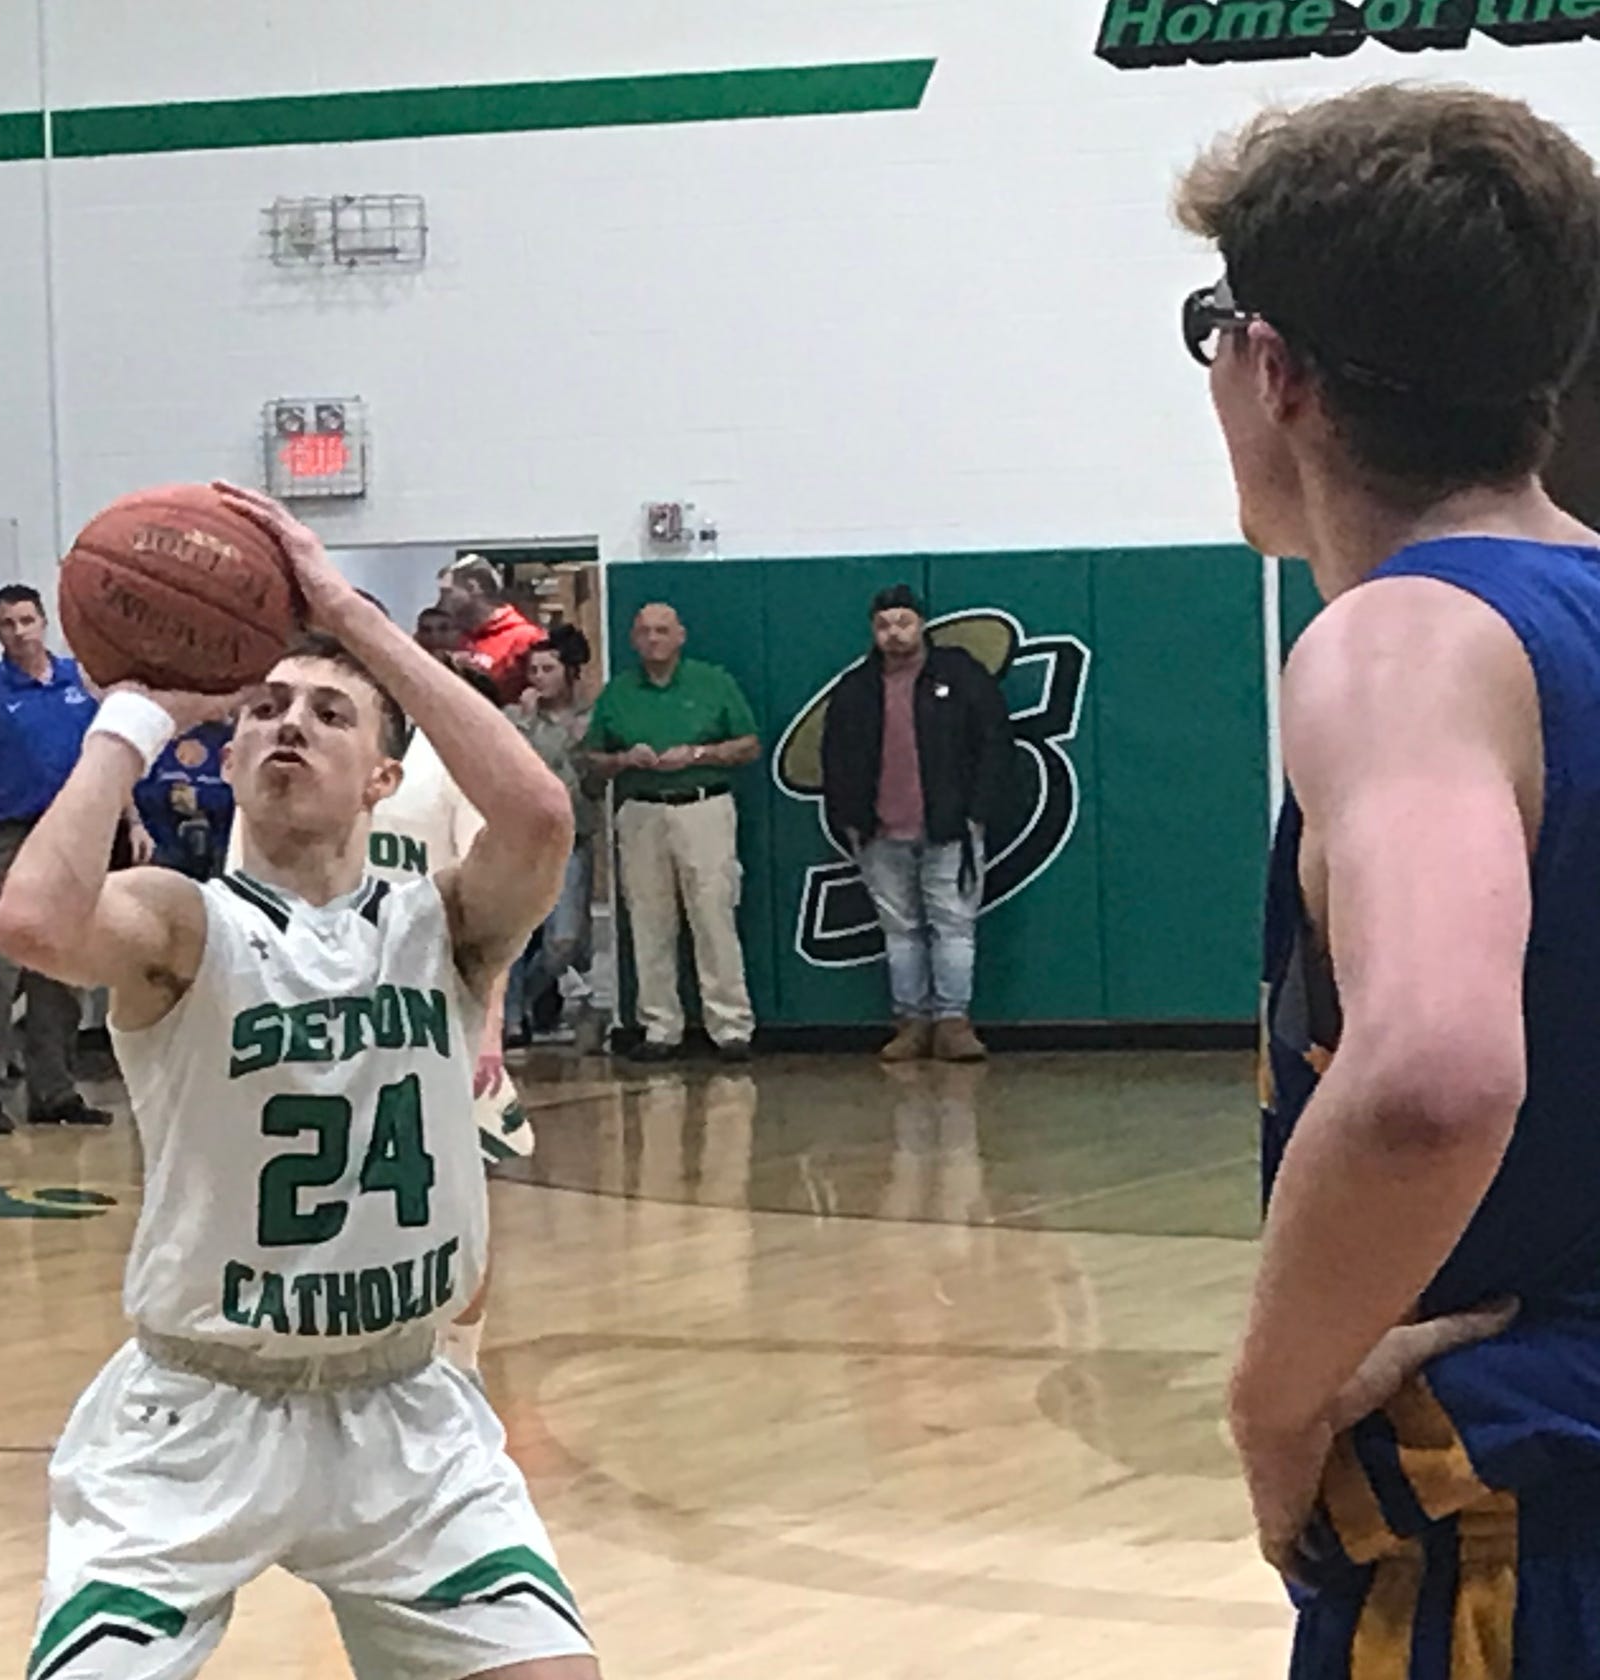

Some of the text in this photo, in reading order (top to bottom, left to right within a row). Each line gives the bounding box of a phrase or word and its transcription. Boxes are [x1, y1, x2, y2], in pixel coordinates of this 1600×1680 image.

[1097, 0, 1340, 55] Home
[229, 983, 451, 1079] SETON
[258, 1072, 436, 1247] 24
[222, 1236, 459, 1338] CATHOLIC
